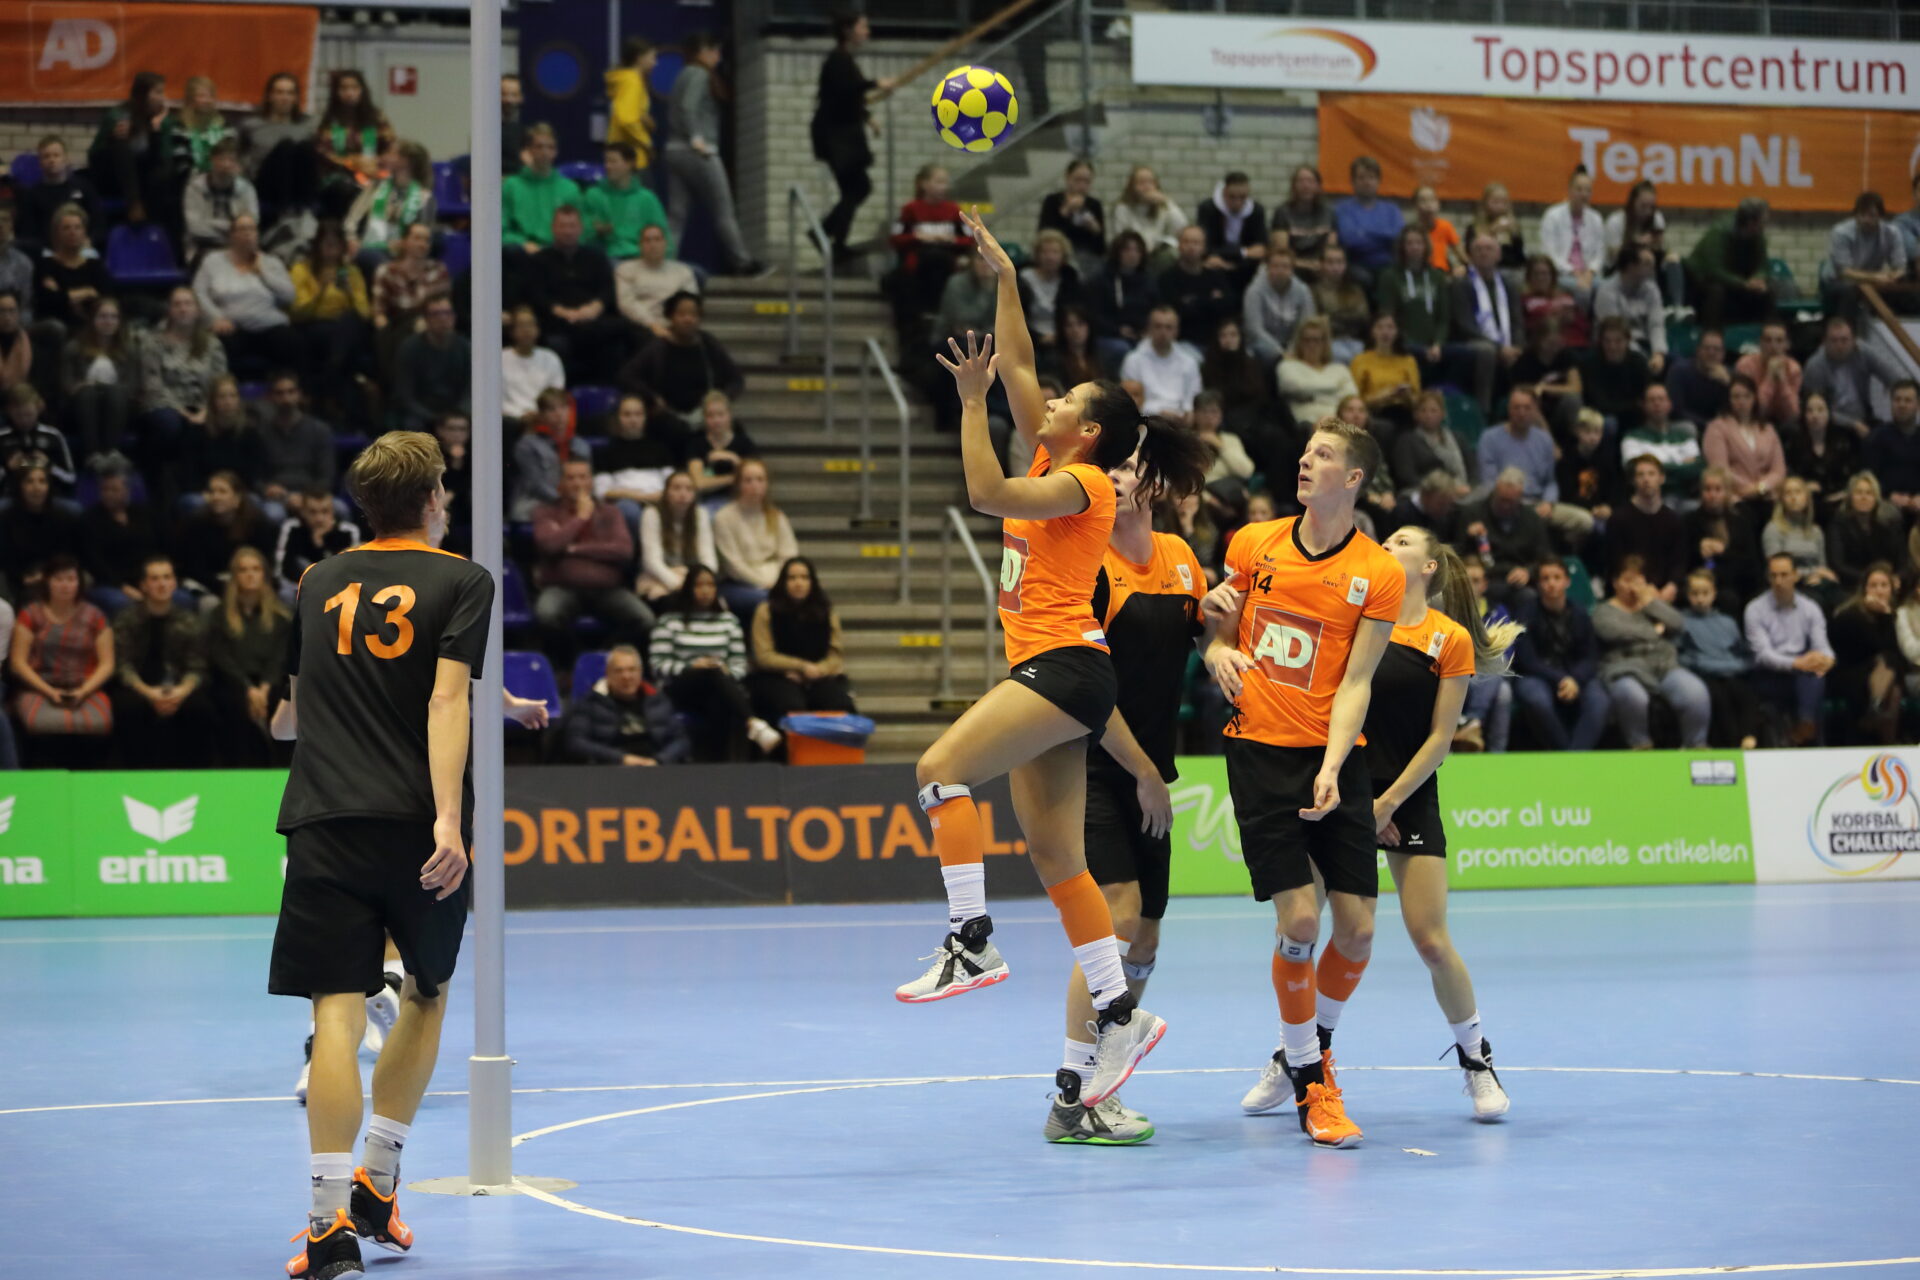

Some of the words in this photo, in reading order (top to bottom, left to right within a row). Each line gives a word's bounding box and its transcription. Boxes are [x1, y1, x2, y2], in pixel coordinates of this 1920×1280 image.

[38, 18, 117, 71] AD
[1473, 37, 1907, 95] Topsportcentrum
[1567, 127, 1814, 188] TeamNL
[1251, 570, 1274, 595] 14
[1256, 560, 1278, 573] erima
[323, 582, 417, 660] 13
[1254, 622, 1314, 669] AD
[468, 802, 1028, 866] ORFBALTOTAL.
[1451, 807, 1511, 828] voor
[1519, 800, 1543, 827] al
[1551, 804, 1592, 827] uw
[1831, 811, 1902, 828] KORFBAL
[98, 848, 229, 884] erima
[1456, 839, 1630, 875] promotionele
[1637, 836, 1749, 864] artikelen
